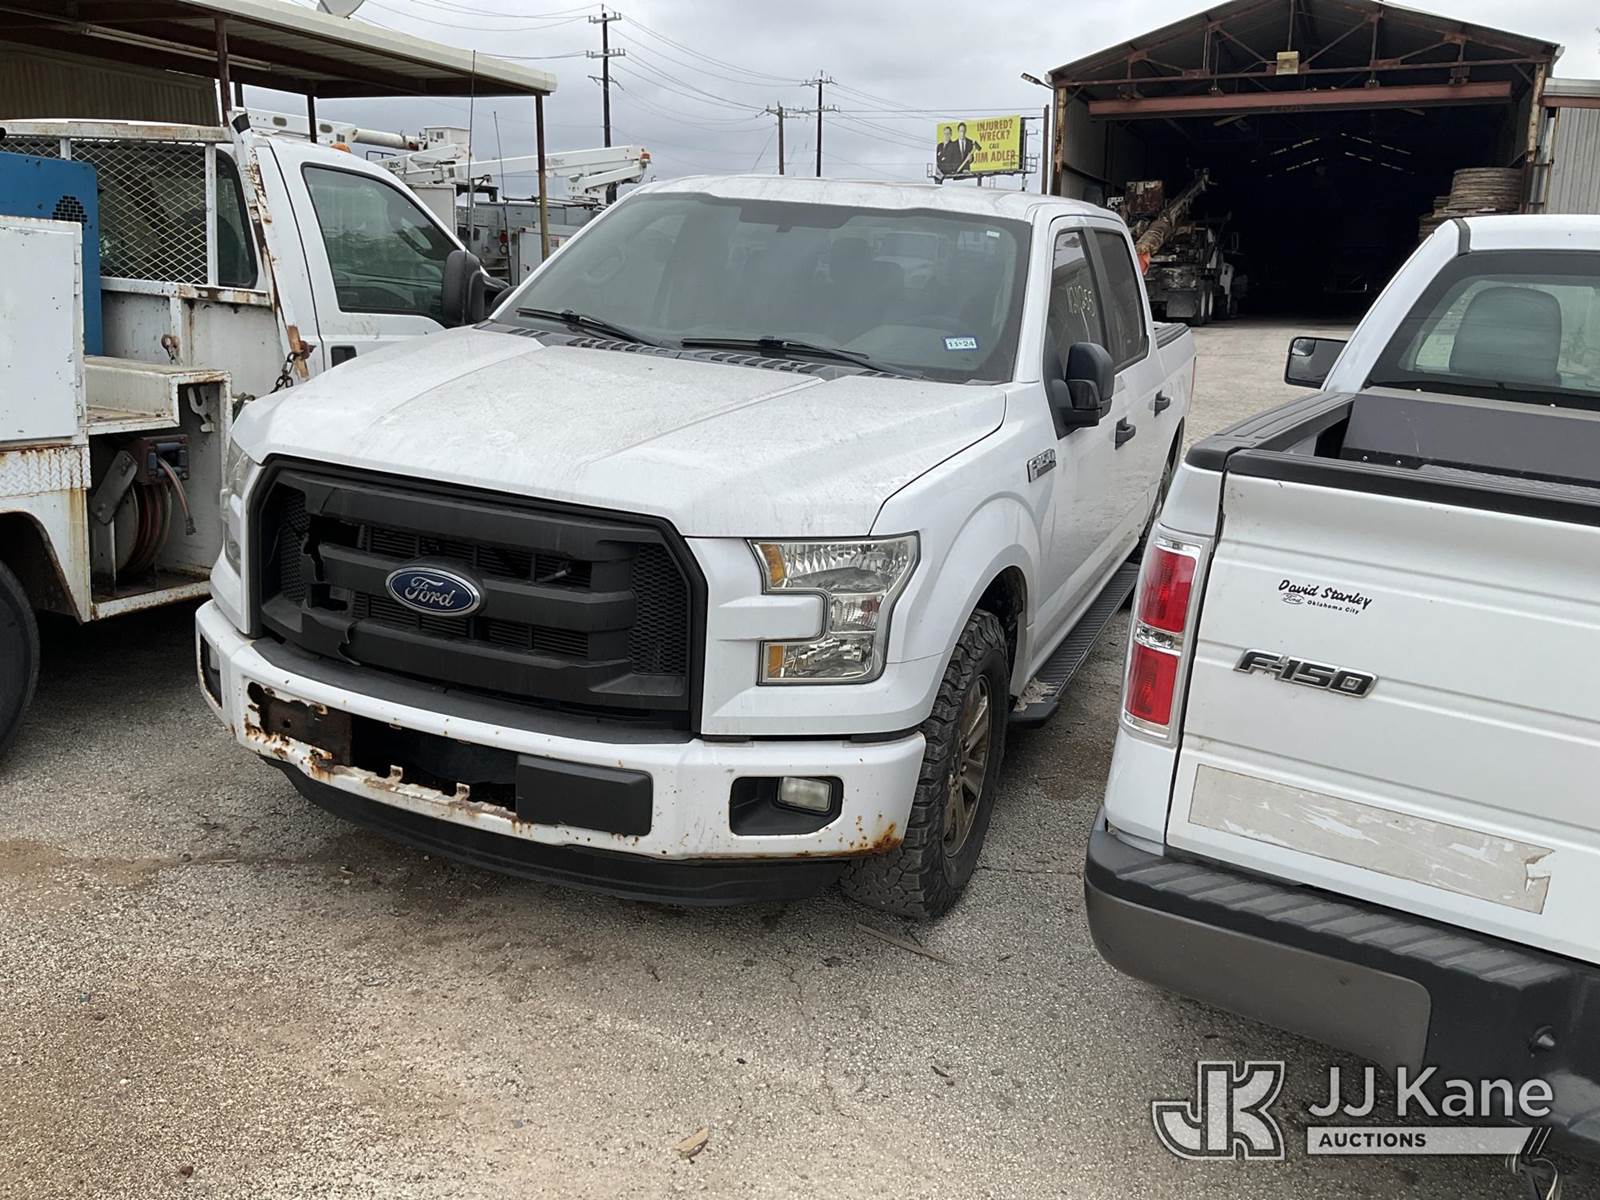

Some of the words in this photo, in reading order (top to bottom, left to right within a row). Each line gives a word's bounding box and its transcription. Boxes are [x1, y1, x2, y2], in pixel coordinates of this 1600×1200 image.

[977, 119, 1012, 130] INJURED?
[979, 130, 1009, 141] WRECK?
[975, 151, 988, 162] JIM
[991, 150, 1015, 161] ADLER
[404, 576, 456, 607] Ford
[1278, 579, 1320, 596] David
[1321, 587, 1372, 610] Stanley
[1307, 600, 1343, 611] Oklahoma
[1345, 606, 1360, 615] City
[1233, 648, 1380, 699] F-150
